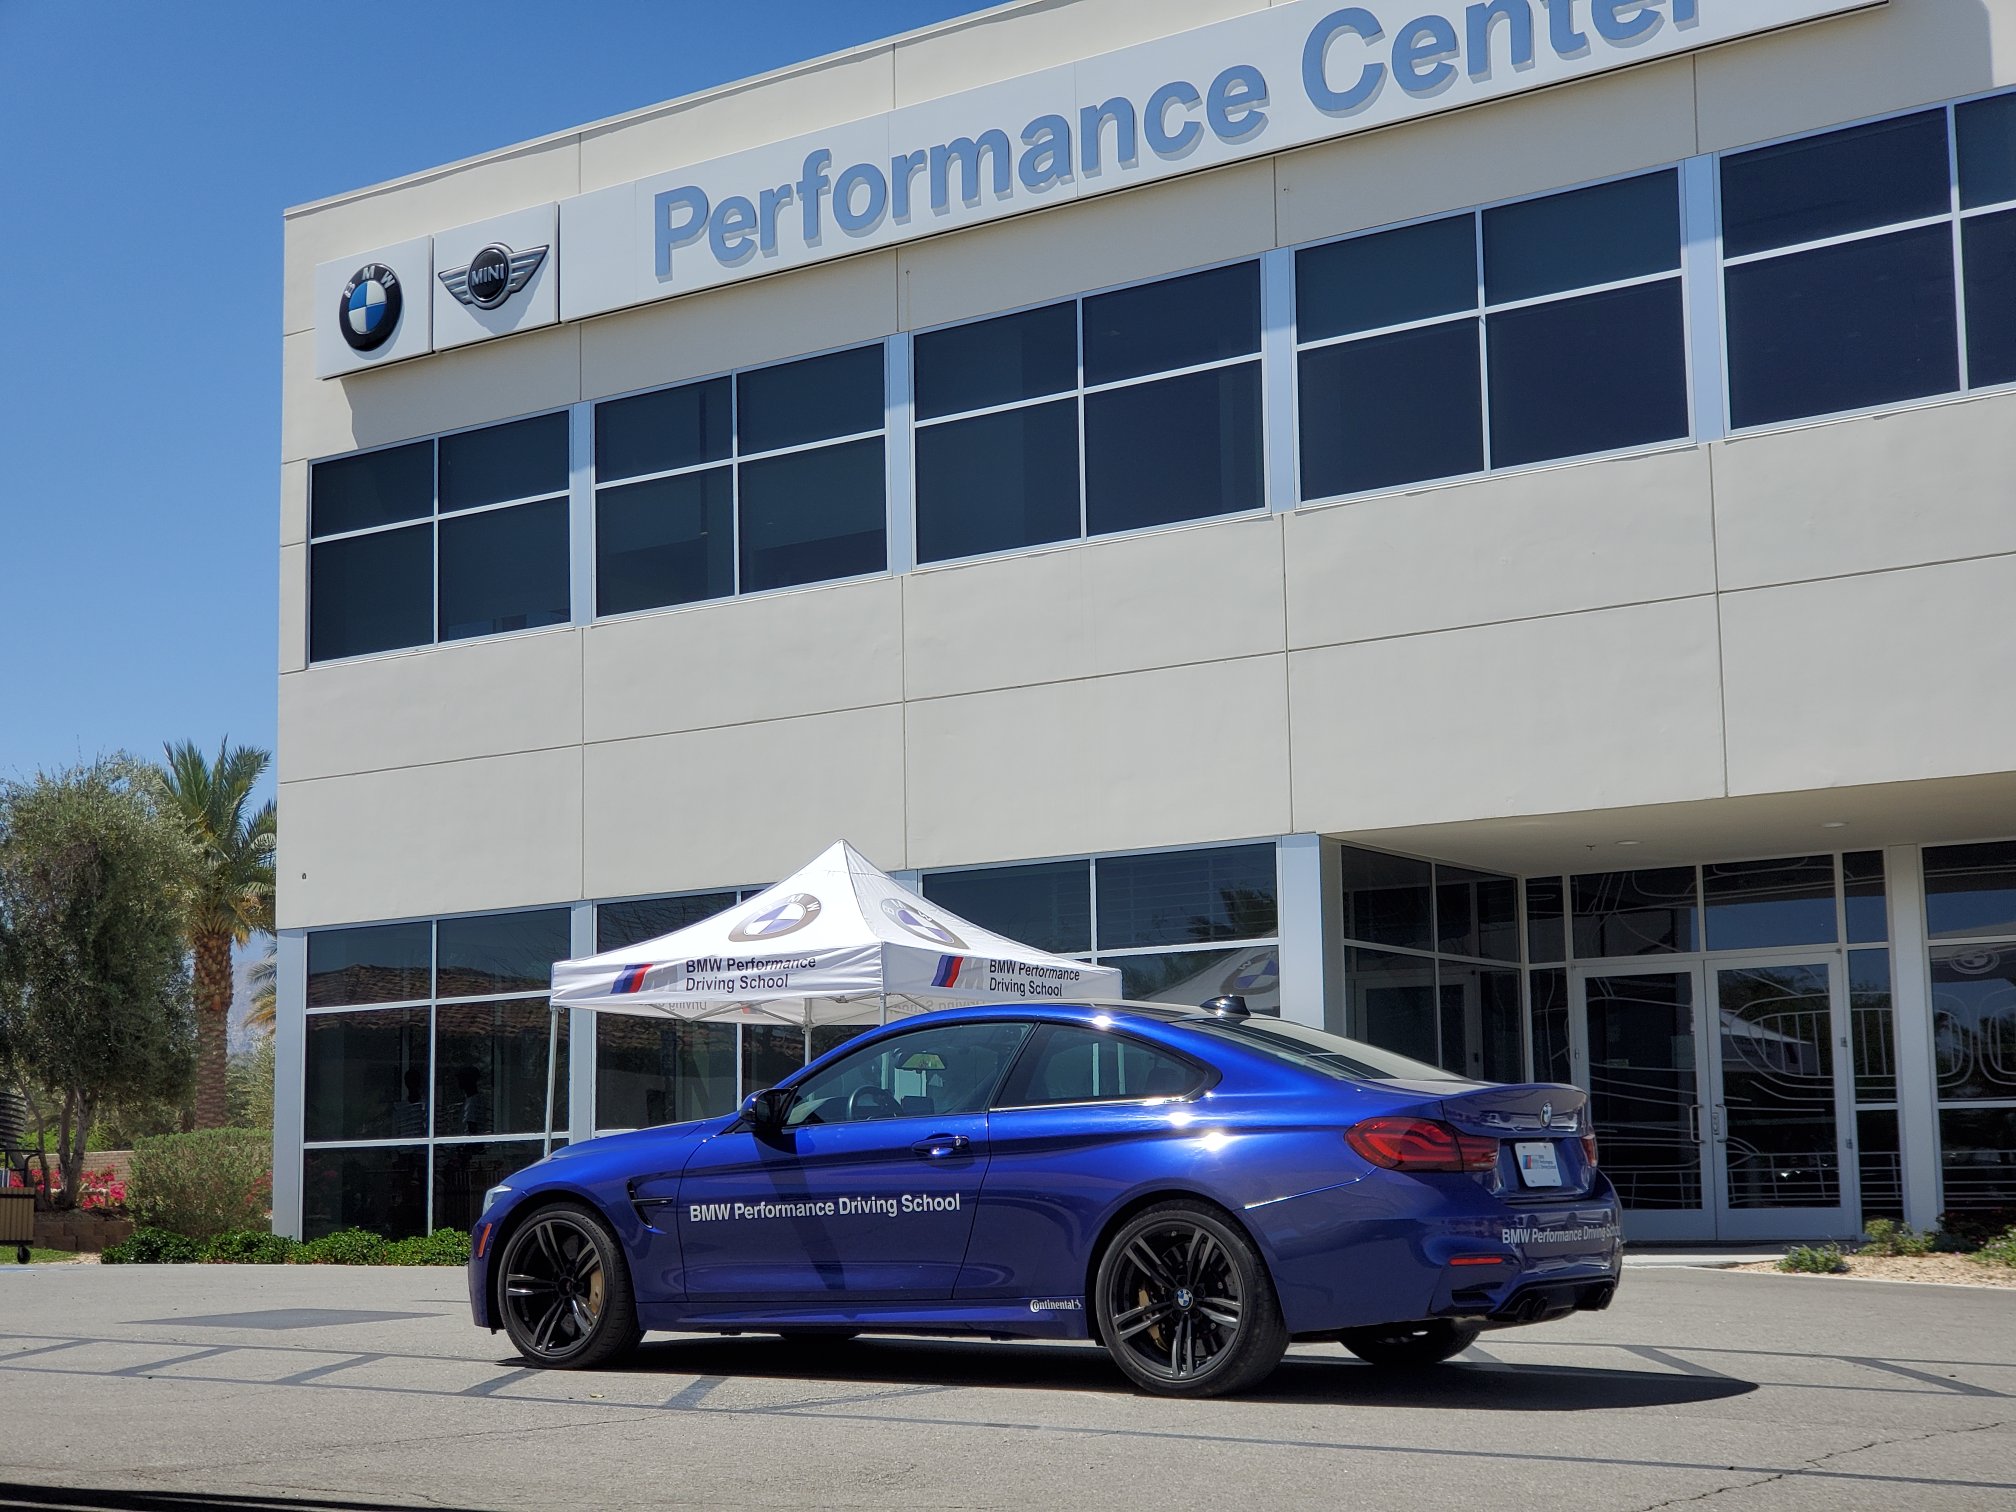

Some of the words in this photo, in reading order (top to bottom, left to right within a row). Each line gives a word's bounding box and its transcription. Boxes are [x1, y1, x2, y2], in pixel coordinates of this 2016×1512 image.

[655, 64, 1268, 277] Performance
[1302, 0, 1696, 109] Cente
[344, 265, 396, 299] BMW
[471, 263, 505, 286] MINI
[686, 958, 722, 973] BMW
[727, 957, 817, 972] Performance
[989, 959, 1016, 975] BMW
[1018, 962, 1080, 981] Performance
[686, 977, 735, 993] Driving
[739, 974, 789, 989] School
[989, 977, 1026, 996] Driving
[1028, 980, 1063, 997] School
[690, 1204, 731, 1222] BMW
[734, 1201, 835, 1220] Performance
[838, 1196, 898, 1217] Driving
[901, 1193, 960, 1213] School
[1502, 1229, 1530, 1244] BMW
[1532, 1228, 1582, 1243] Performance
[1583, 1225, 1606, 1242] Driving
[1030, 1299, 1075, 1313] Continental
